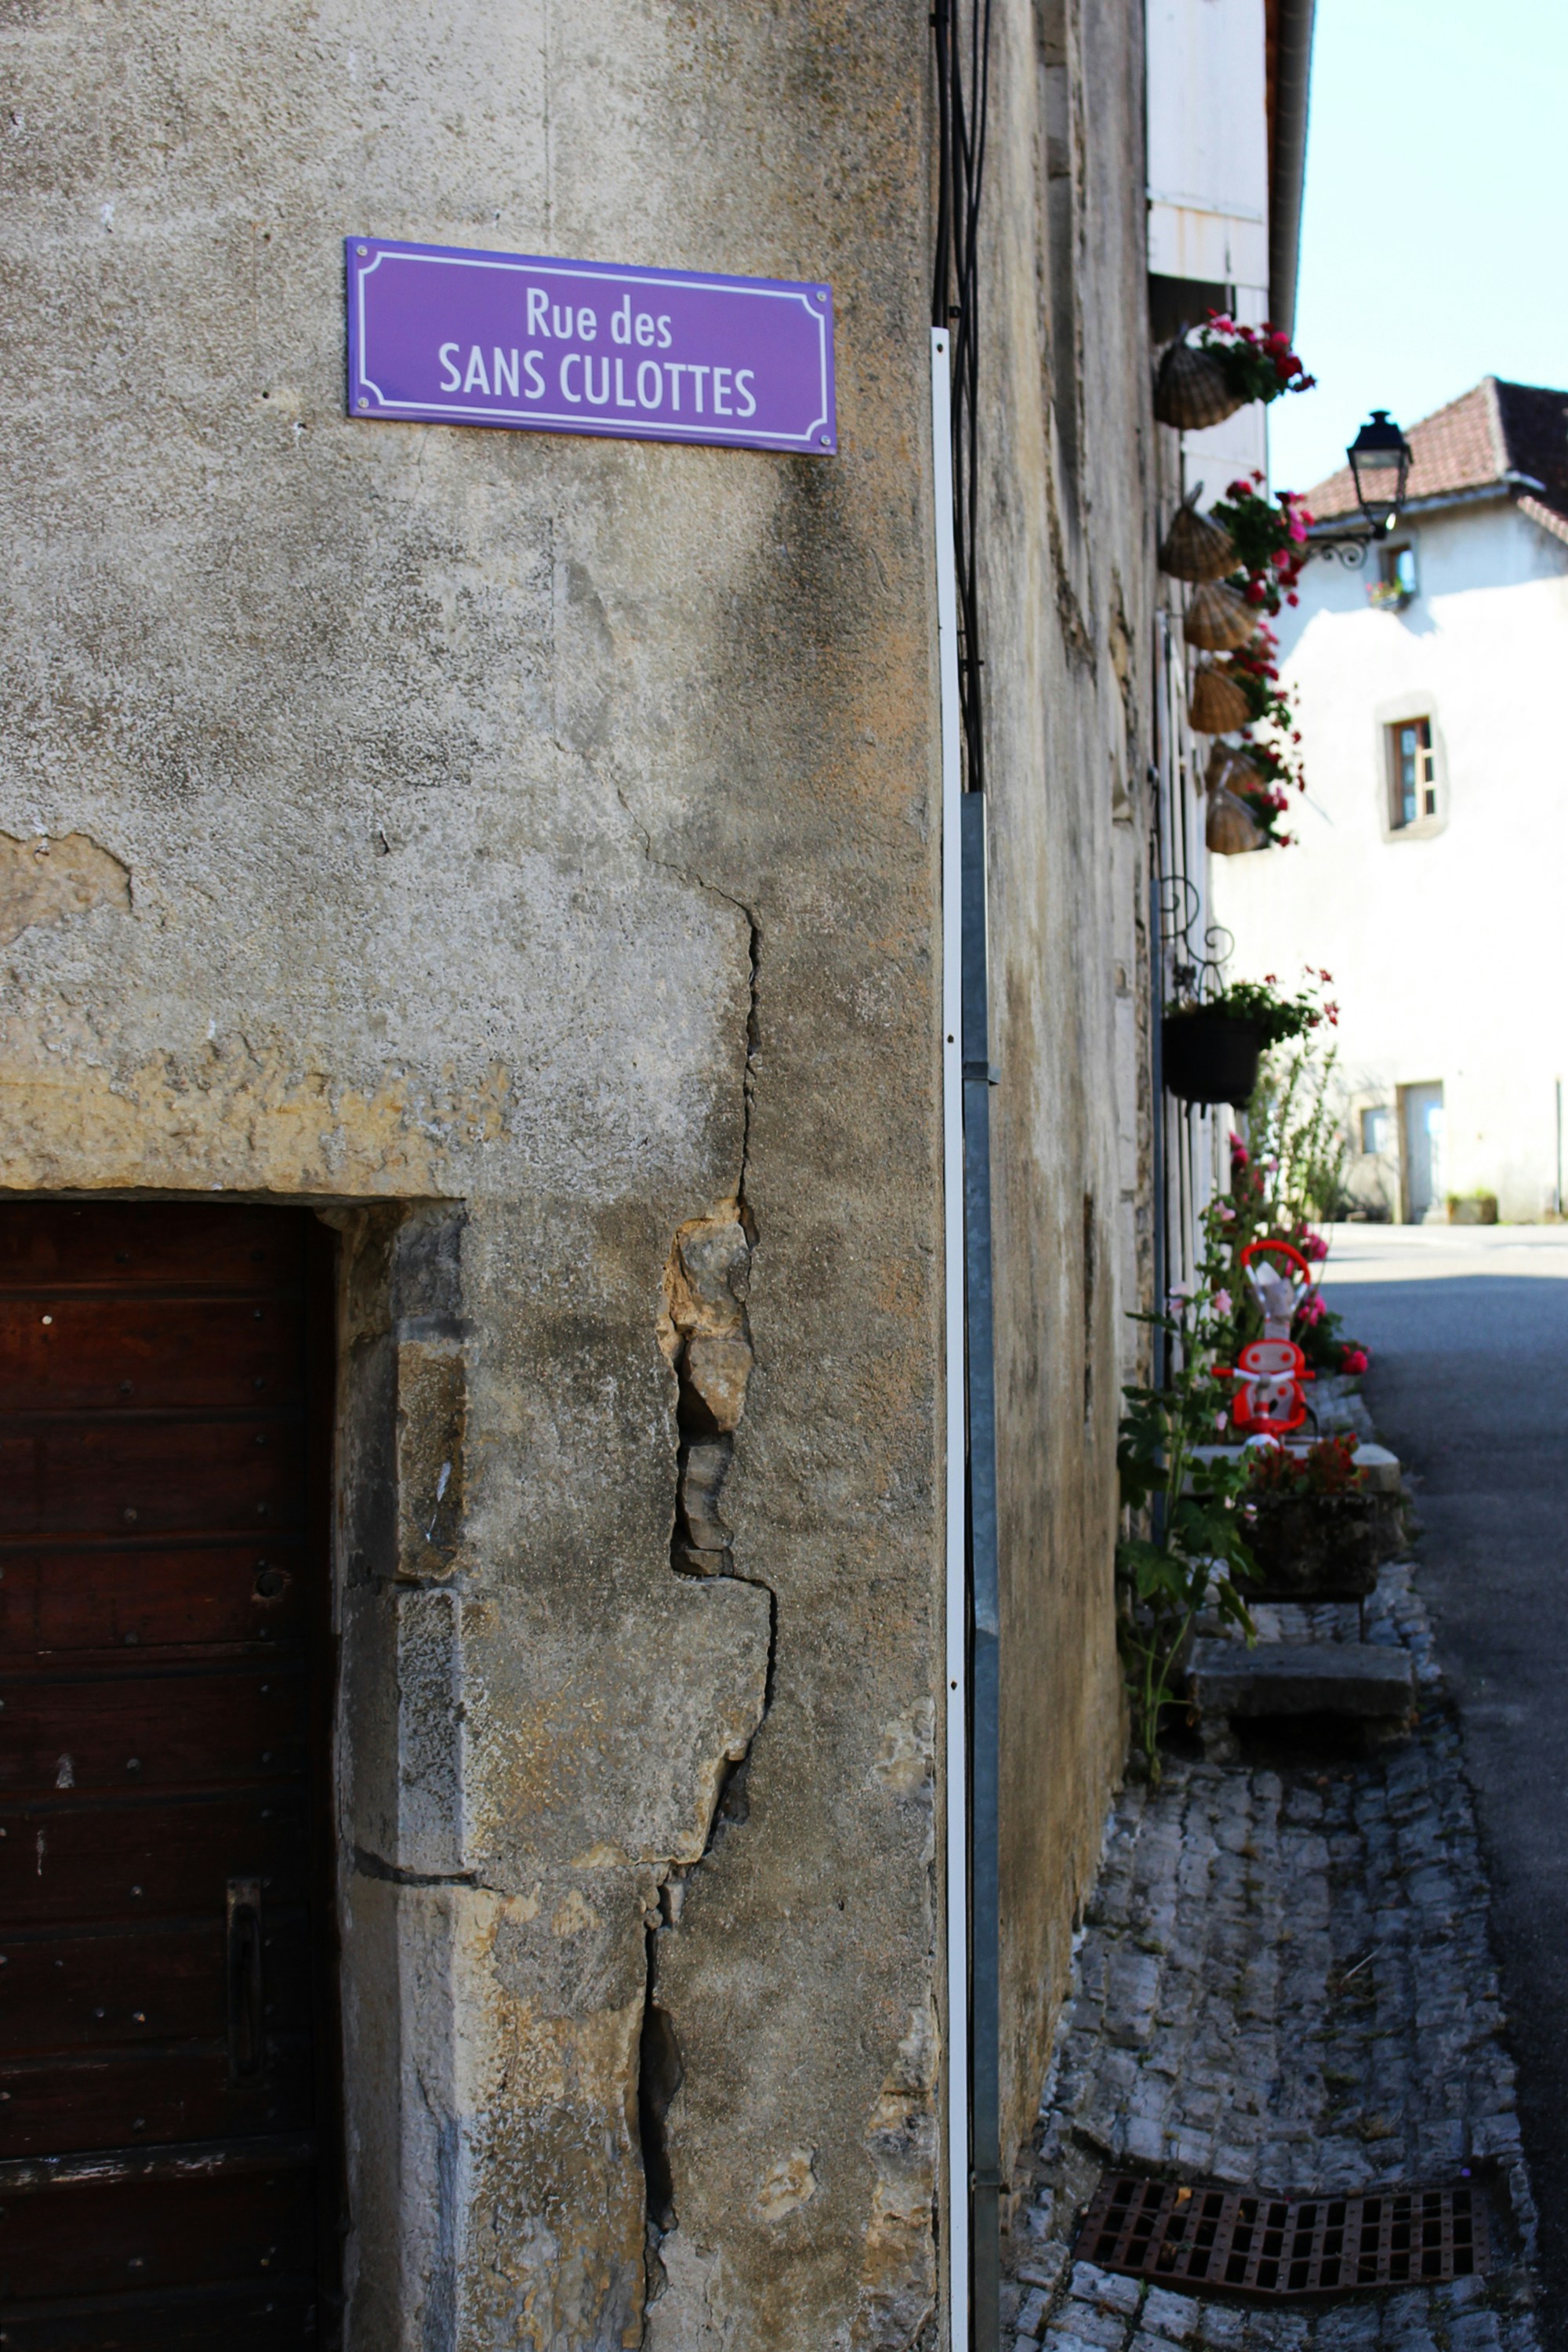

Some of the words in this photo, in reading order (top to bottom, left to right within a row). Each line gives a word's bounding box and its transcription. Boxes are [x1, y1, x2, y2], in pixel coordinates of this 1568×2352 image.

[526, 287, 597, 340] Rue
[610, 294, 673, 348] des
[438, 343, 546, 400] SANS
[559, 354, 757, 417] CULOTTES
